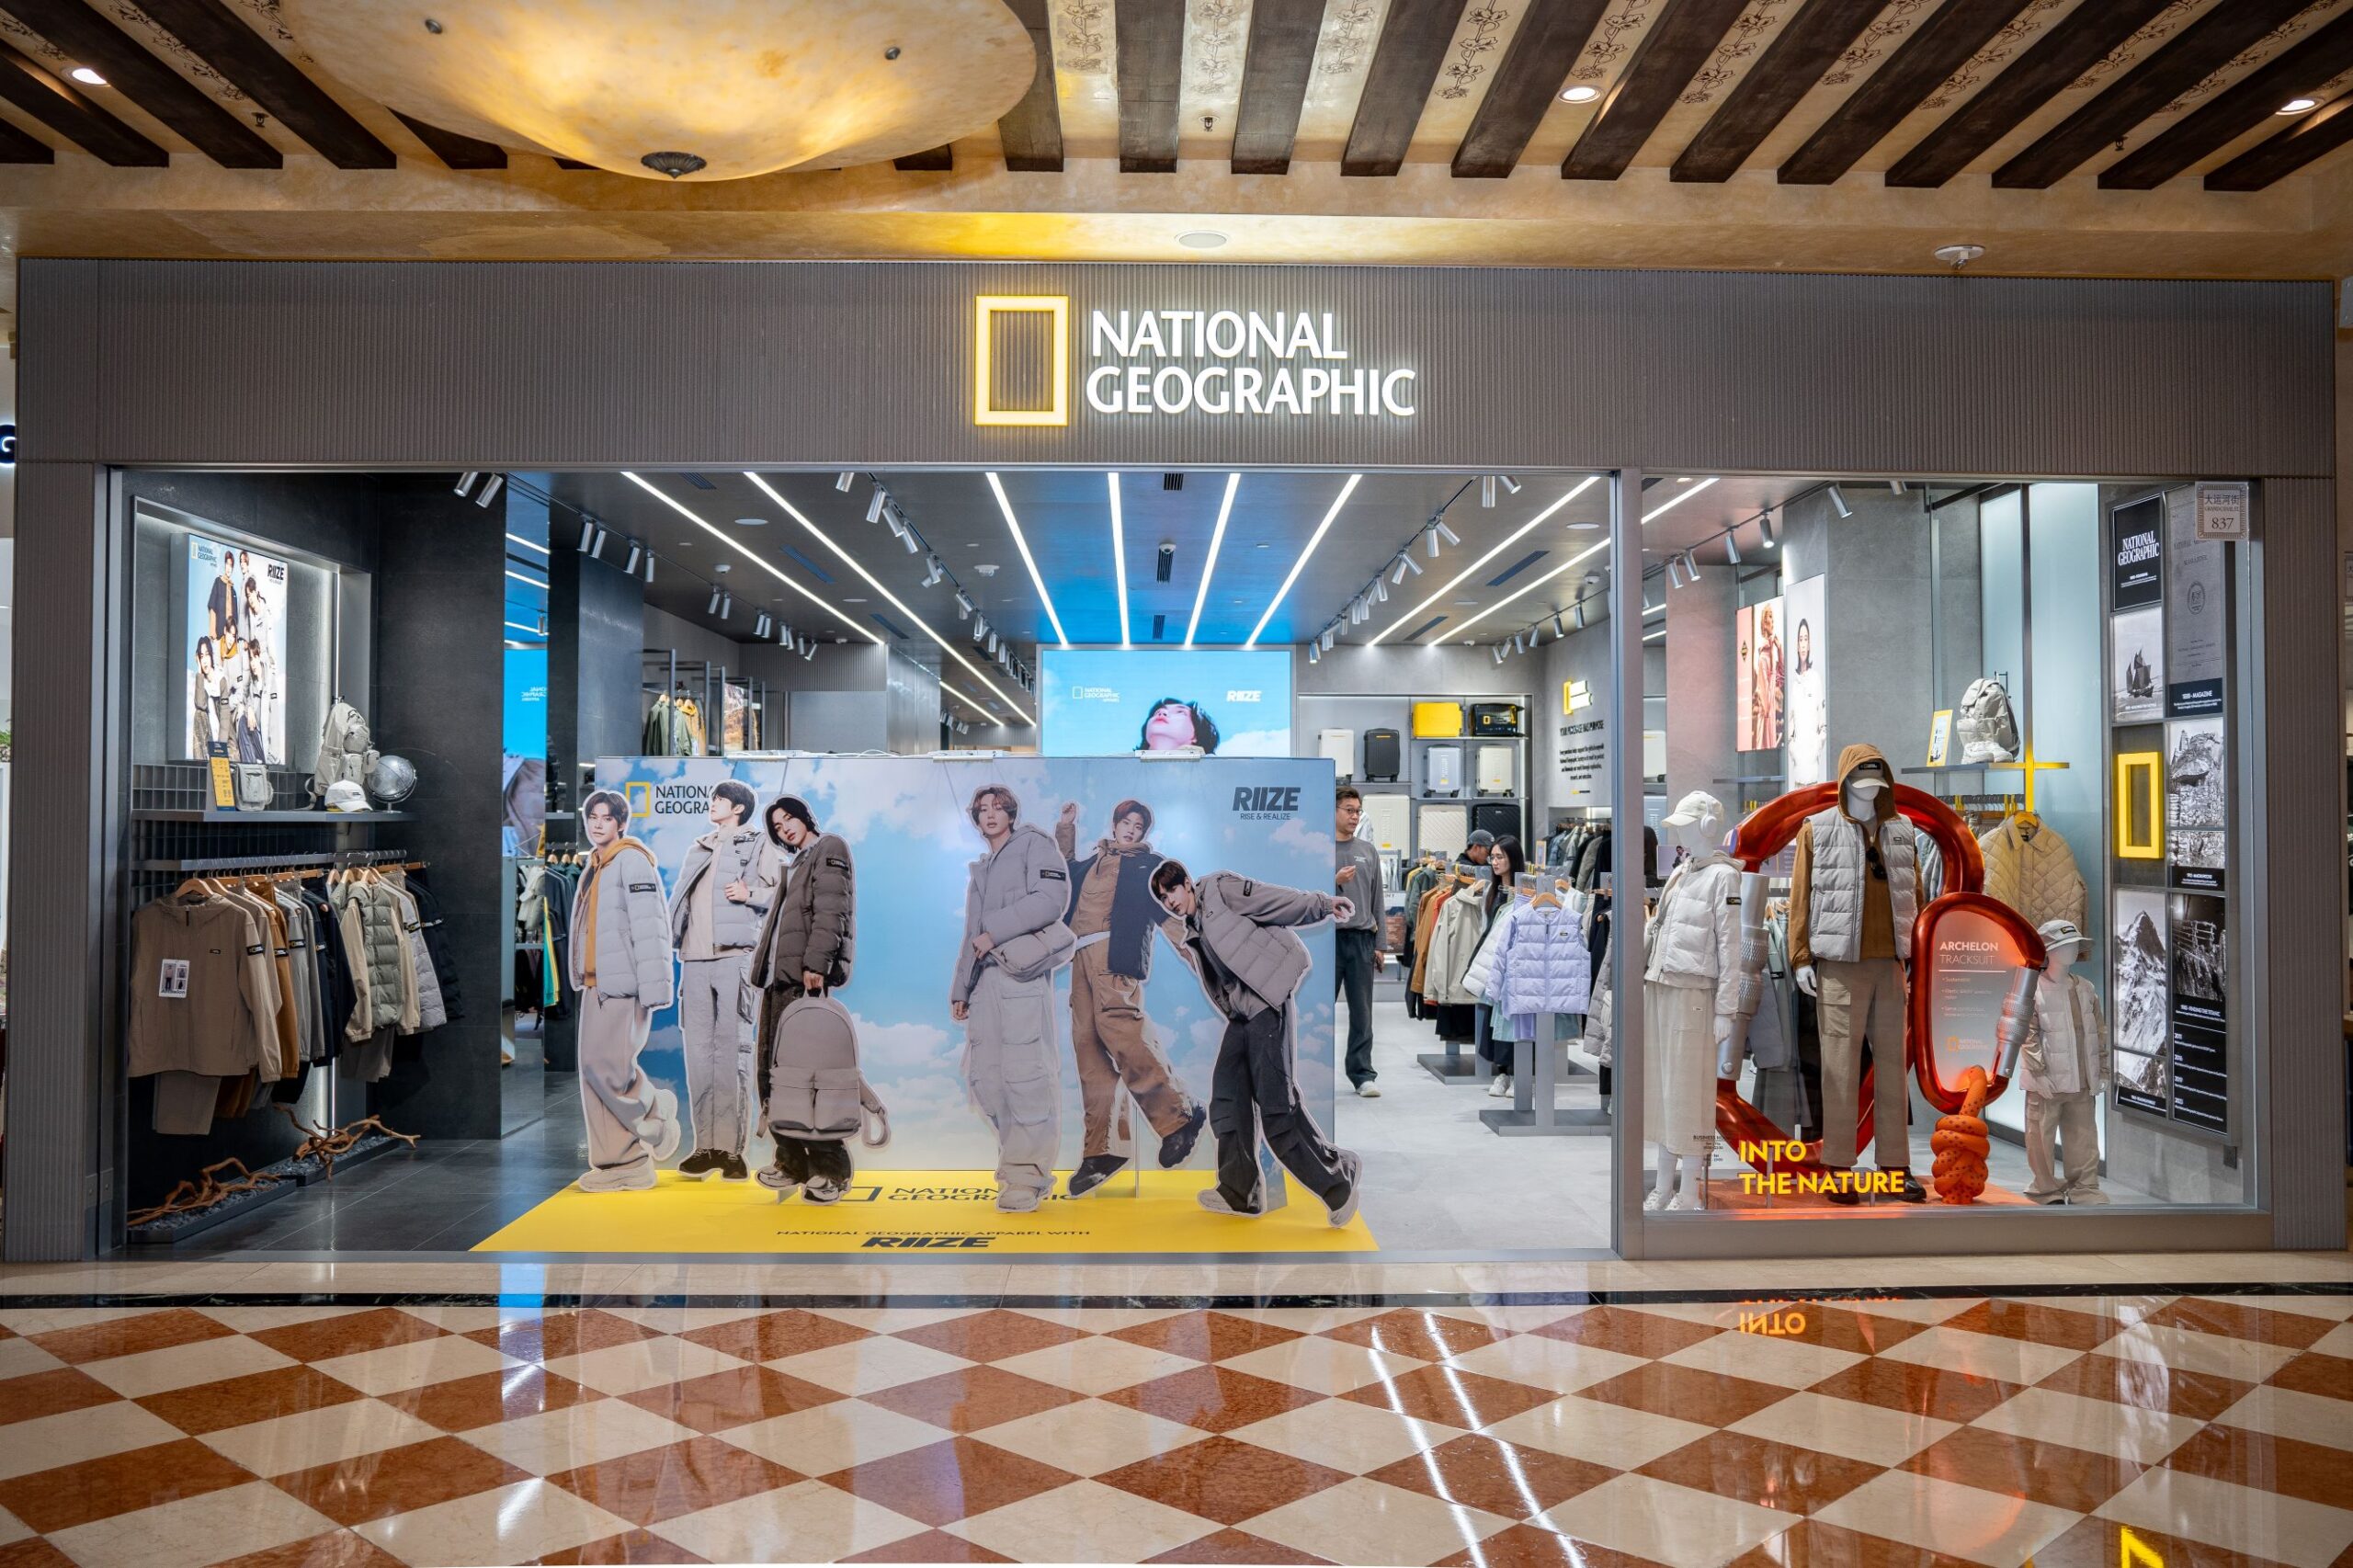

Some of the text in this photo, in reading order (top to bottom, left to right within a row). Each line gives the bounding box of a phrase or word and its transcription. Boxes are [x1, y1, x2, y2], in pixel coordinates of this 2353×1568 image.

[1091, 310, 1347, 358] NATIONAL
[1086, 365, 1415, 415] GEOGRAPHIC
[2211, 517, 2234, 529] 837
[2122, 530, 2155, 551] NATIONAL
[2118, 542, 2159, 566] GEOGRAPHIC
[267, 564, 285, 581] RIIZE
[1226, 690, 1262, 702] RIIZE
[655, 785, 713, 799] NATION
[1233, 787, 1302, 812] RIIZE
[654, 801, 710, 814] GEOGRA
[1240, 812, 1290, 821] RISE & REALIZE
[1939, 941, 1999, 951] ARCHELON
[1939, 955, 1995, 965] TRACKSUIT
[1738, 1140, 1807, 1163] INTO
[1737, 1171, 1904, 1195] THE NATURE
[860, 1237, 996, 1247] RIIZE
